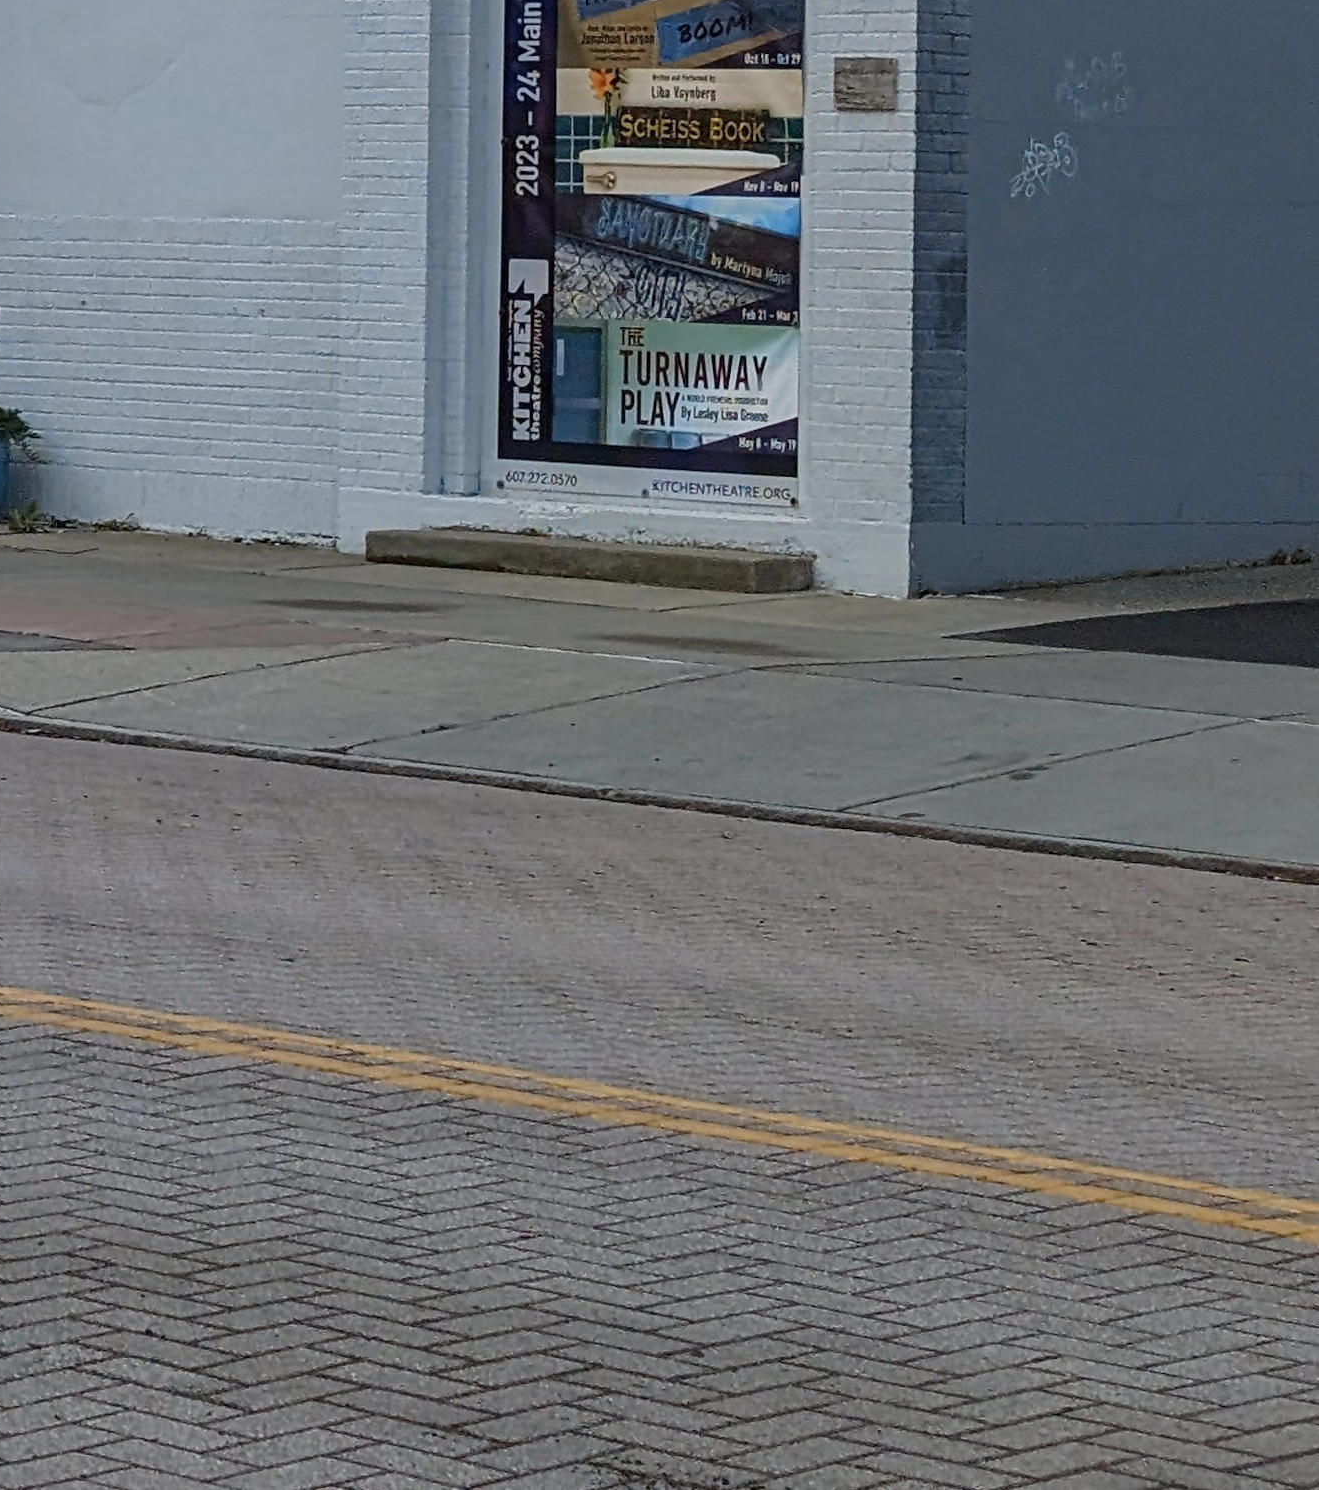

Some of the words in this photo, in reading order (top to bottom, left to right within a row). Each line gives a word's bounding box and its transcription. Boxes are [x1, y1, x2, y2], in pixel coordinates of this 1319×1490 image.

[517, 1, 543, 62] Main
[677, 10, 753, 44] BOOM!
[744, 53, 759, 65] Oct
[777, 53, 790, 65] Oct
[517, 69, 541, 102] 24
[620, 113, 701, 140] SCHEISS
[710, 117, 765, 142] BOOK
[516, 134, 539, 196] 2023
[710, 252, 722, 270] by
[723, 255, 763, 278] Martyna
[742, 308, 756, 320] Feb
[776, 310, 790, 322] Mar
[533, 309, 545, 377] company
[619, 326, 645, 347] THE
[512, 299, 532, 441] KITCHEN
[618, 350, 768, 391] TURNAWAY
[531, 376, 542, 441] theatre
[620, 389, 680, 427] PLAY
[681, 406, 692, 421] By
[693, 406, 719, 423] Lesley
[721, 408, 739, 421] Lisa
[738, 436, 754, 451] May
[770, 438, 786, 453] May
[651, 479, 791, 501] KITCHENTHEATRE.ORG
